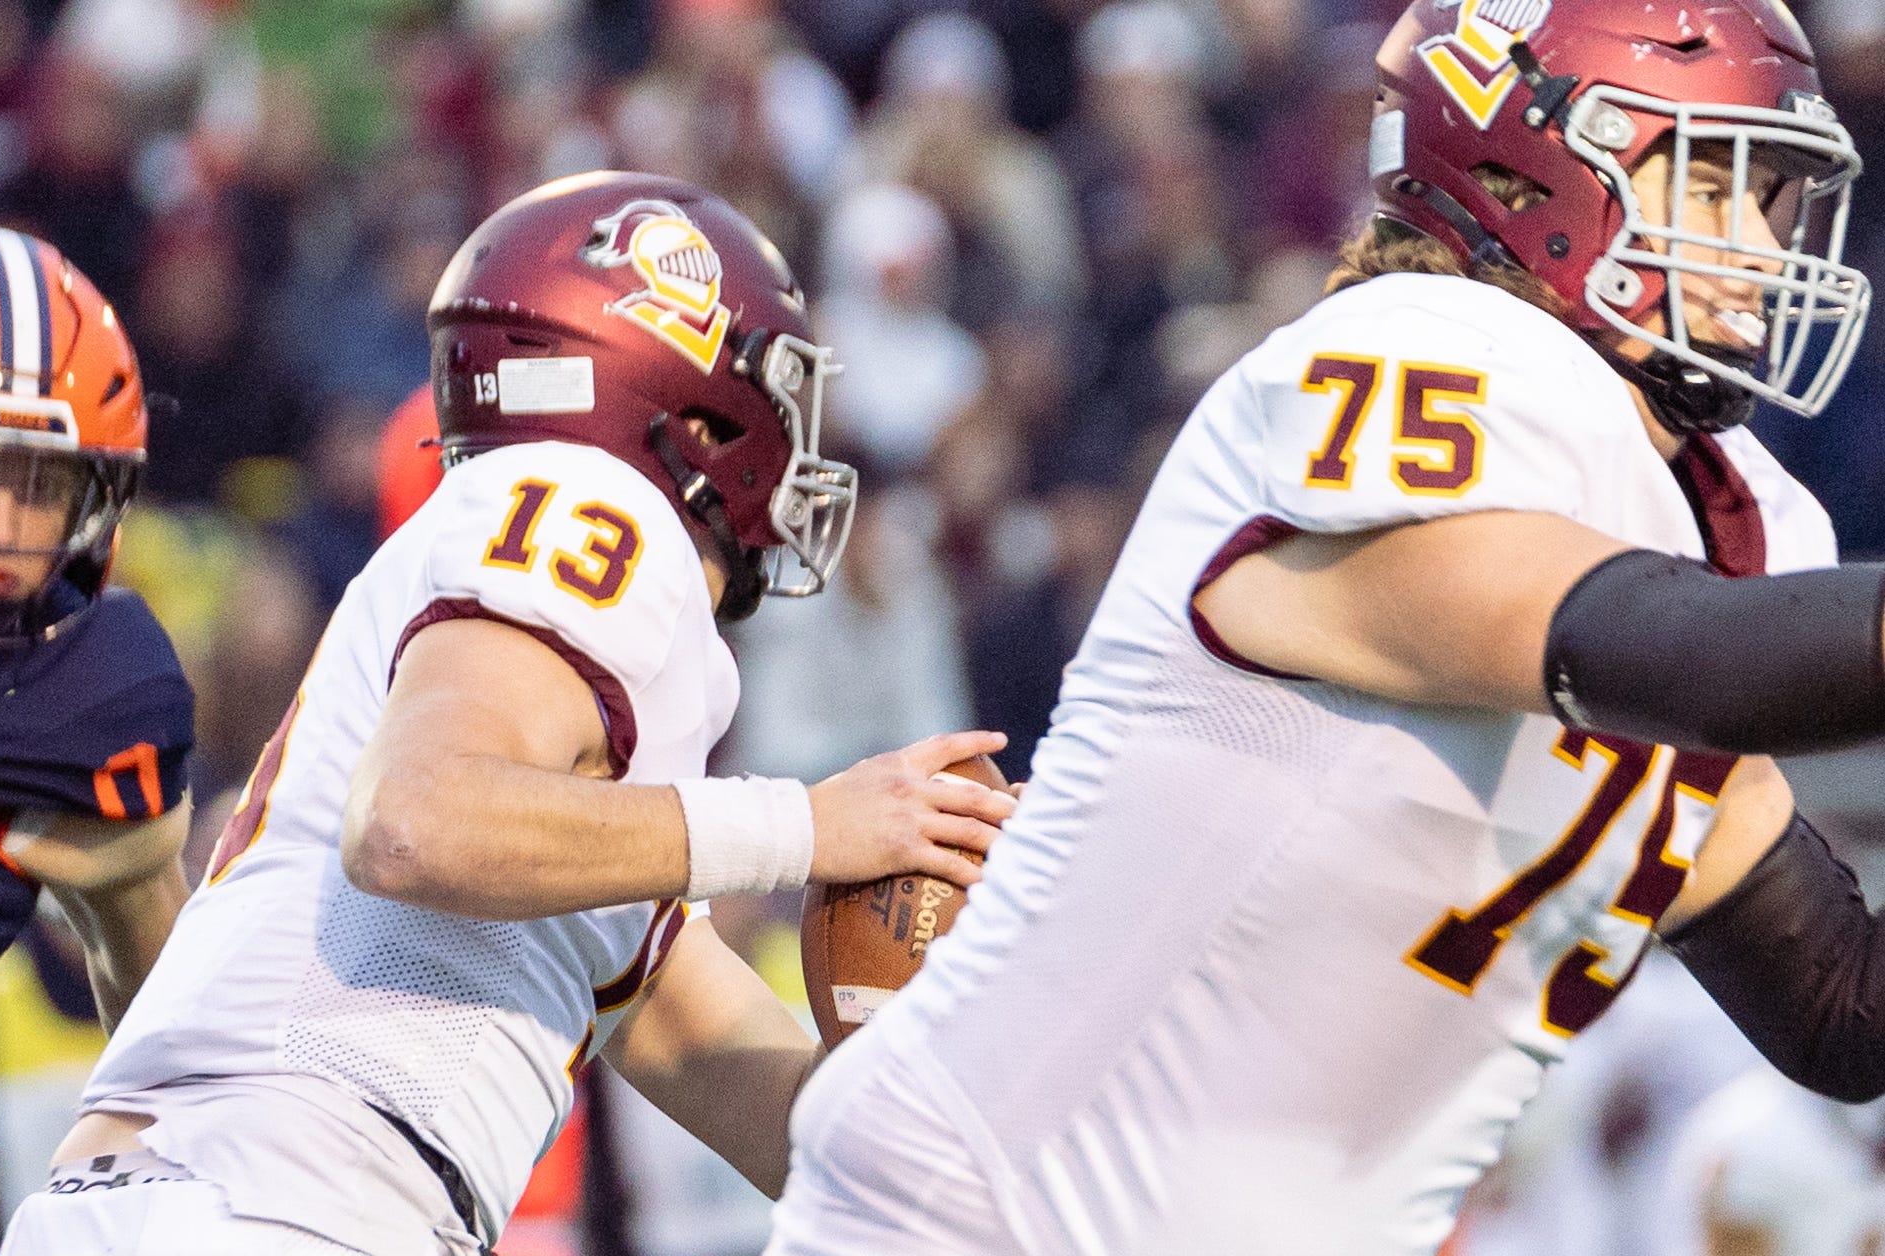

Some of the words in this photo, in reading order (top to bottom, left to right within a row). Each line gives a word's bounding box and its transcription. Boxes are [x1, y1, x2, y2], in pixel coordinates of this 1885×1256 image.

[474, 372, 497, 404] 13
[1302, 352, 1488, 497] 75
[482, 477, 644, 609] 13
[912, 878, 954, 956] lson
